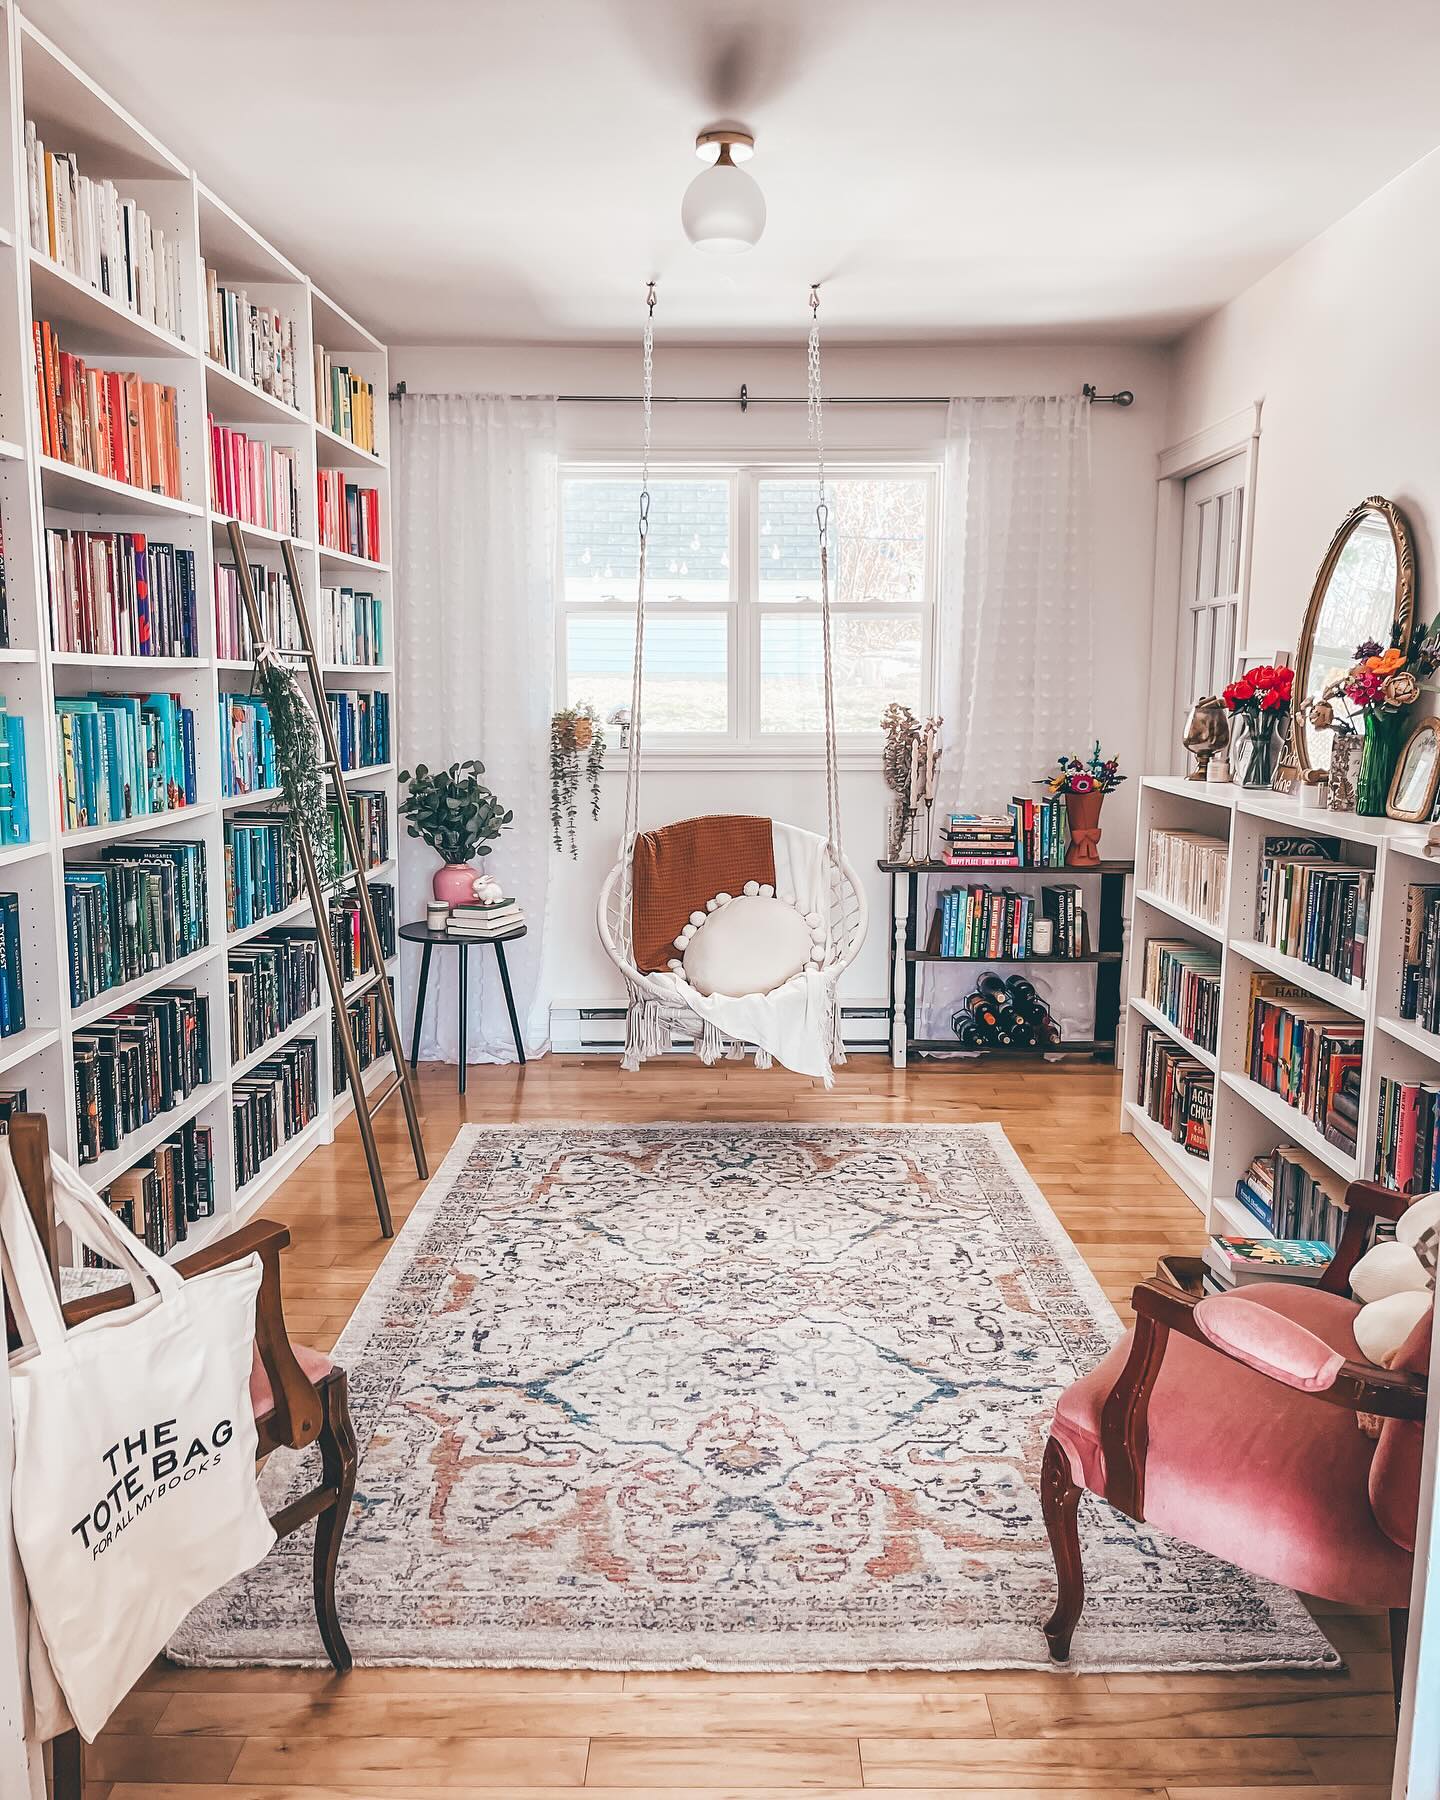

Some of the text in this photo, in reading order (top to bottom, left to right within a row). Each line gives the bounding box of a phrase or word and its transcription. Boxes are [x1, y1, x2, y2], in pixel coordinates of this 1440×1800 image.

[71, 1420, 232, 1549] TOTE BAG
[103, 1418, 178, 1476] THE
[93, 1454, 221, 1560] FOR ALL MY BOOKS
